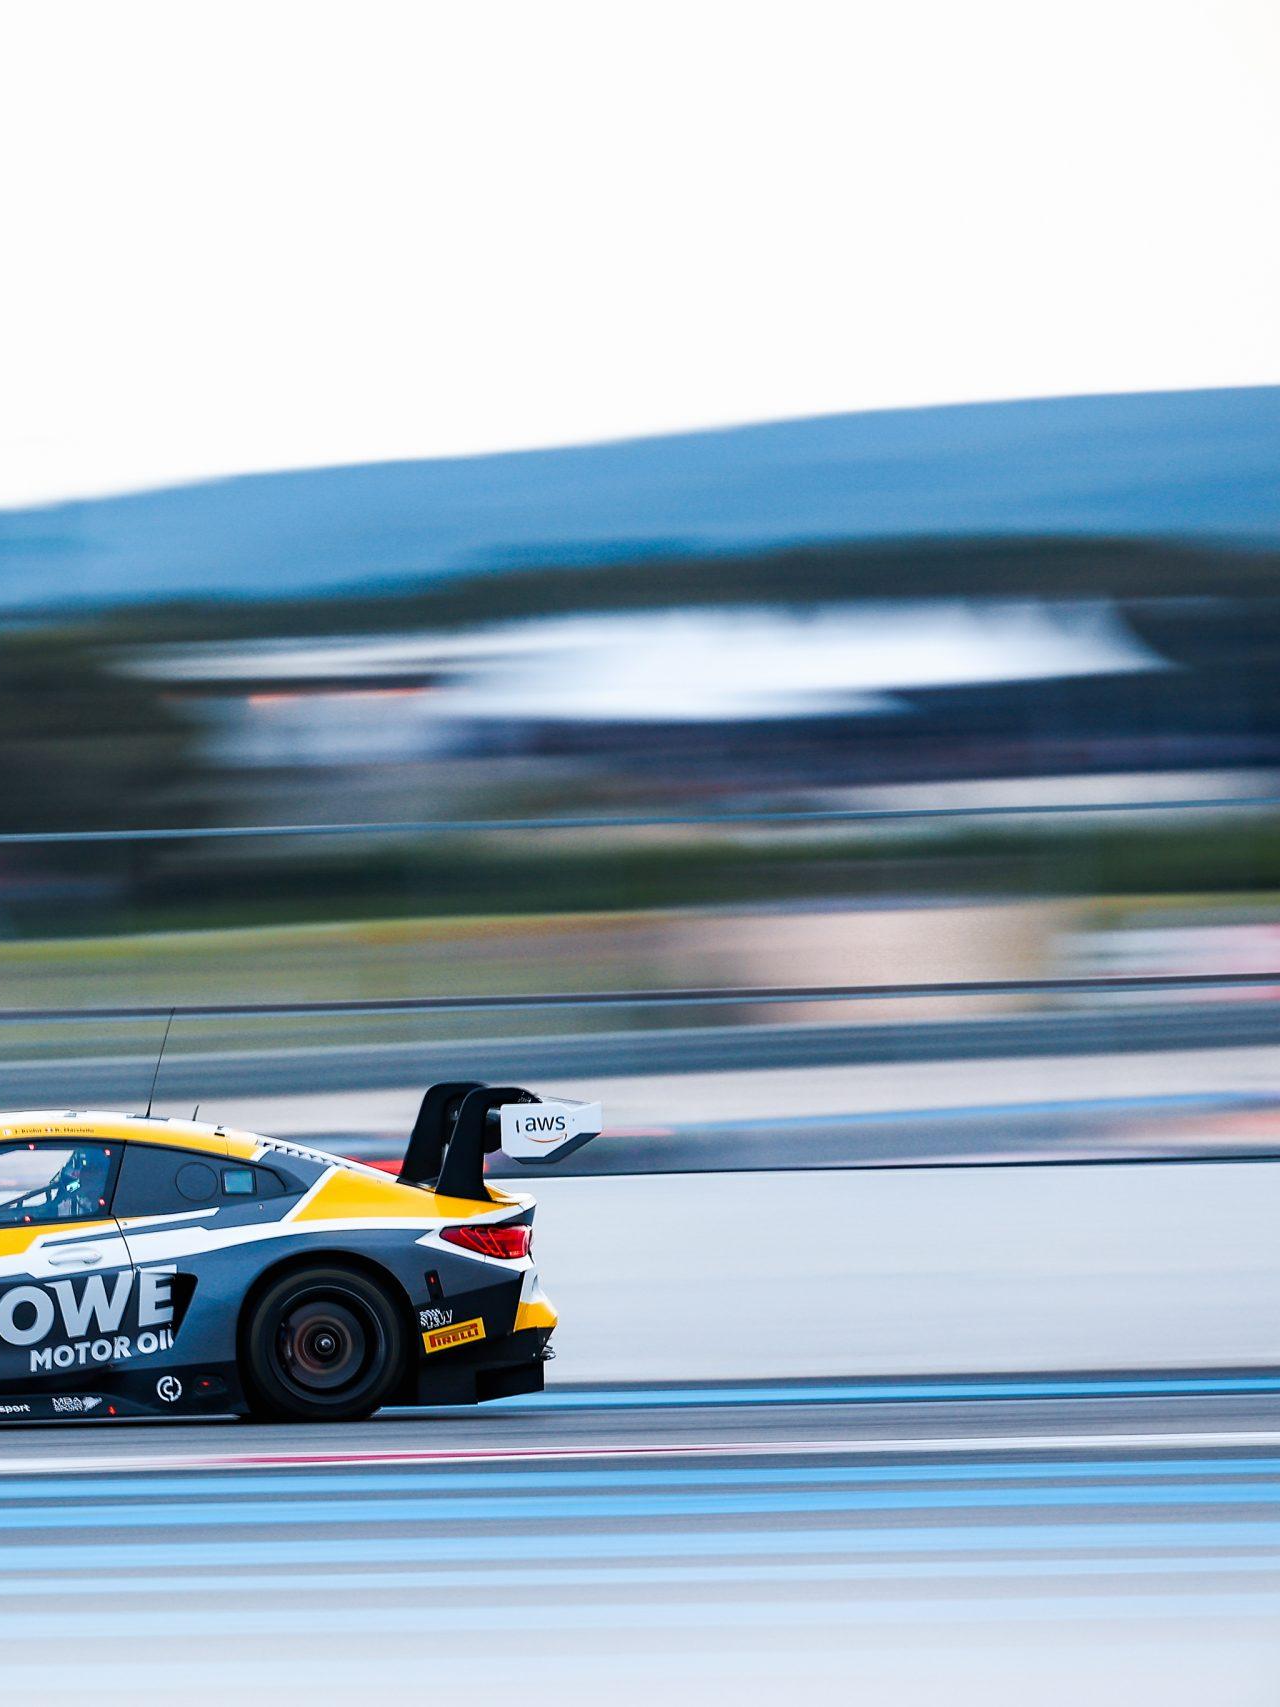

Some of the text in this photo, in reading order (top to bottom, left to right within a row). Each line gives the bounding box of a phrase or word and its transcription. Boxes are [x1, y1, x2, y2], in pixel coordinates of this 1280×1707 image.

[525, 1115, 566, 1132] aws
[429, 1323, 478, 1348] PIRELLI
[30, 1336, 132, 1373] MOTOR
